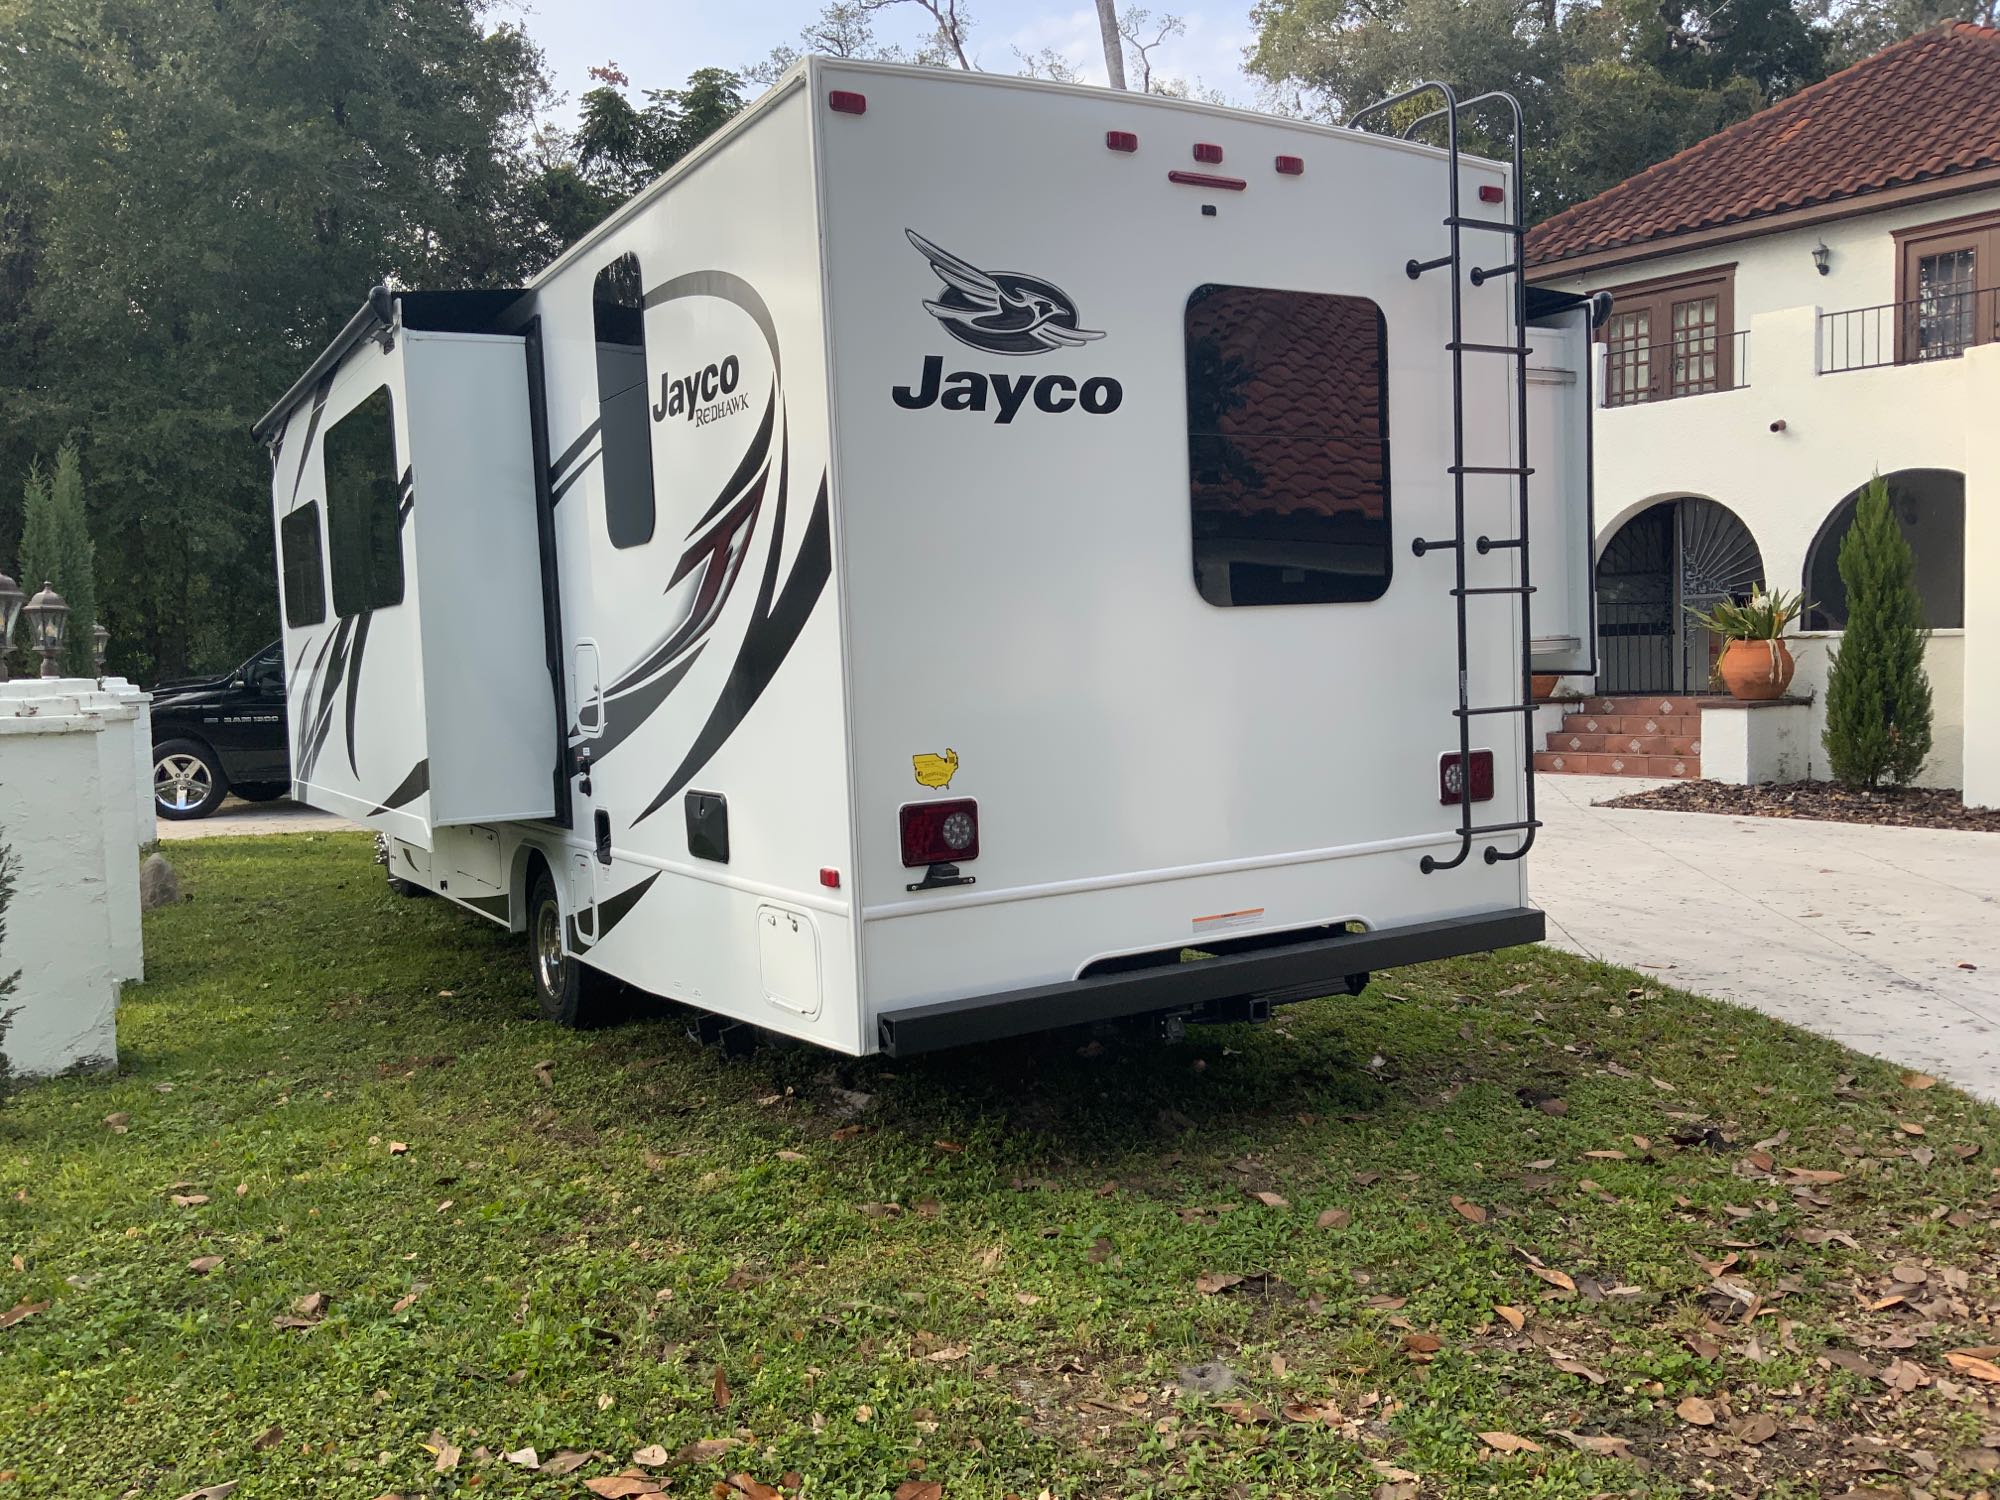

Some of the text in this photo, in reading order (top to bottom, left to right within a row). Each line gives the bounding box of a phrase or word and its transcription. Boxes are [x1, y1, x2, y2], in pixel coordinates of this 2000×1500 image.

[652, 354, 739, 422] Jayco
[695, 392, 749, 427] REDHAWK
[892, 355, 1123, 424] Jayco
